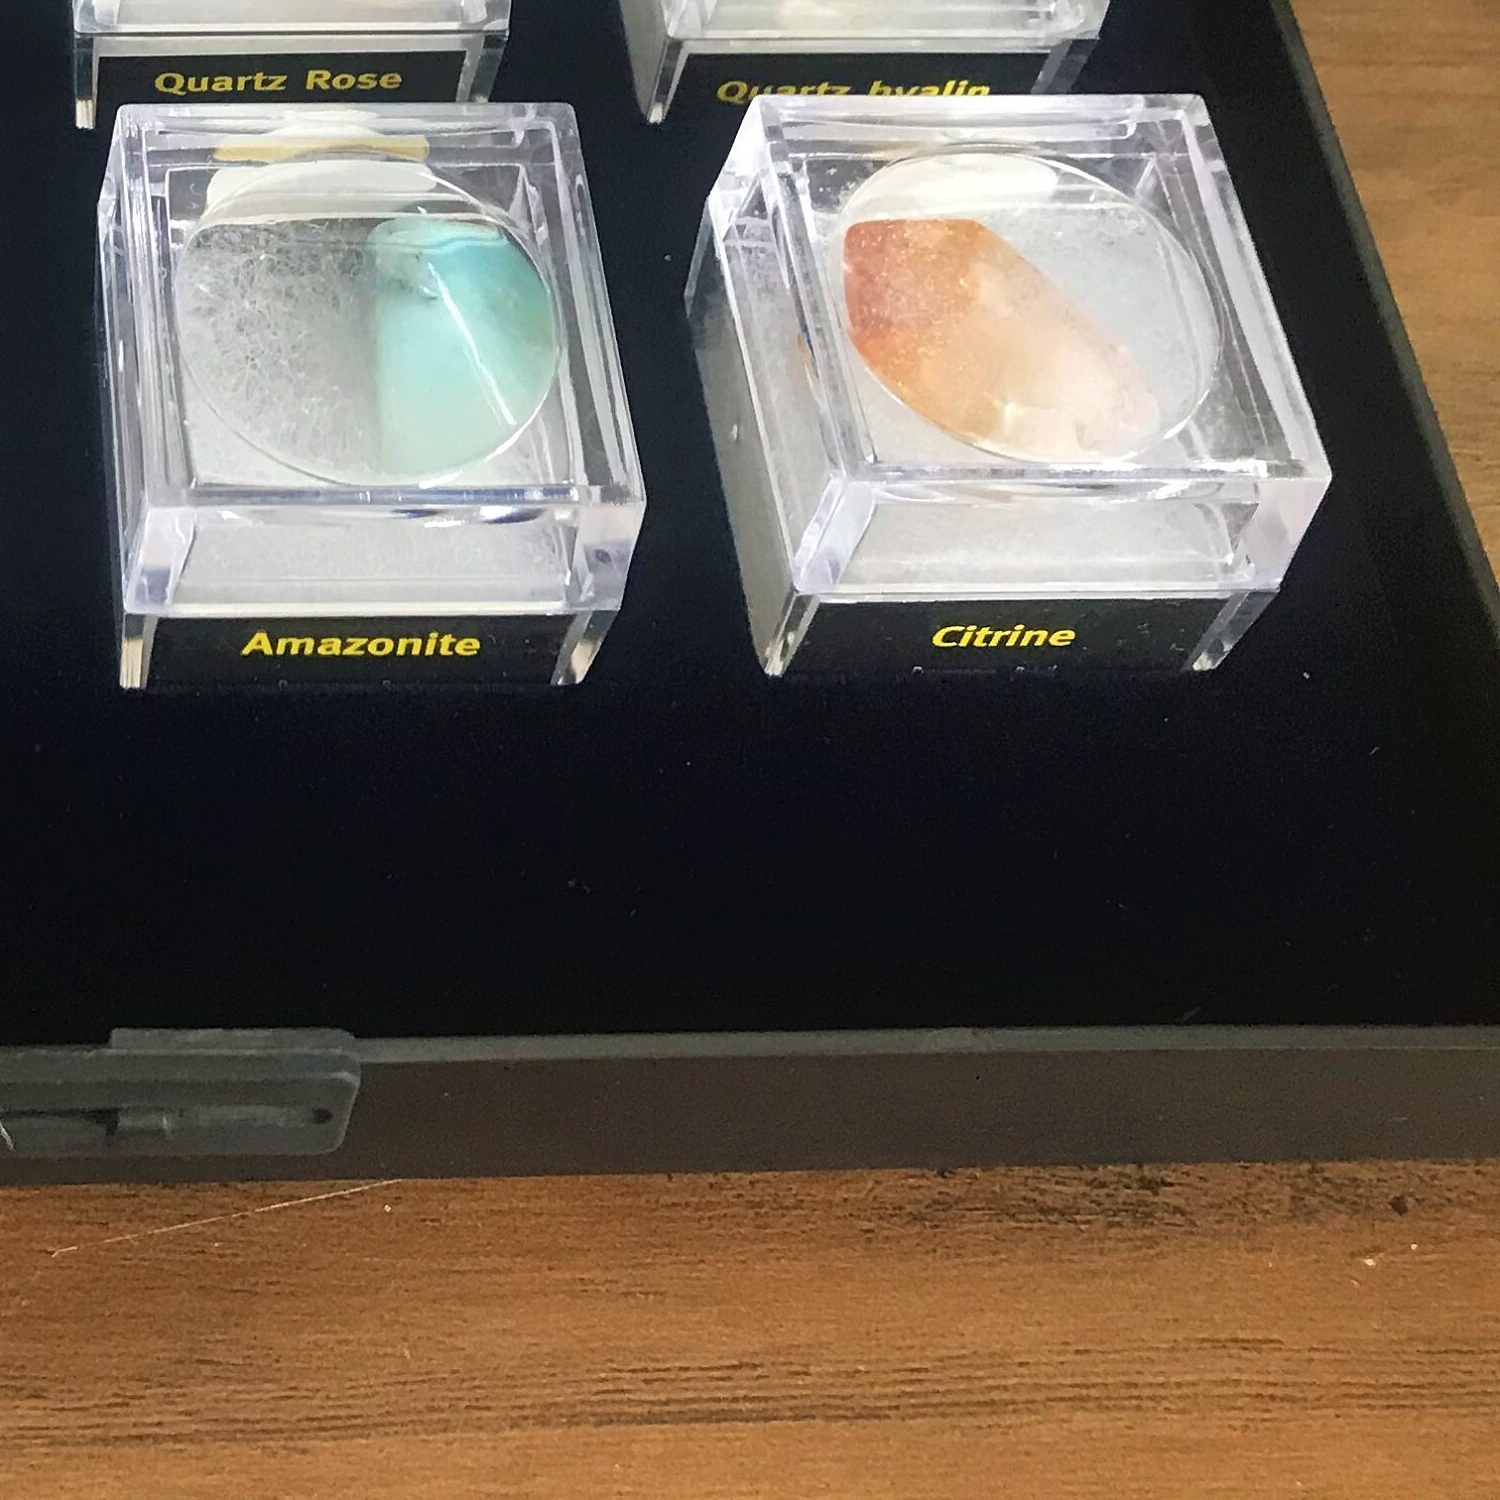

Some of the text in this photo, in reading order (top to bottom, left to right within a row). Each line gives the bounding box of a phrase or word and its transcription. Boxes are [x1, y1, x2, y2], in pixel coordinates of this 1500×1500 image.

[154, 69, 403, 96] Quartz Rose
[241, 630, 481, 656] Amazonite
[930, 623, 1076, 649] Citrine
